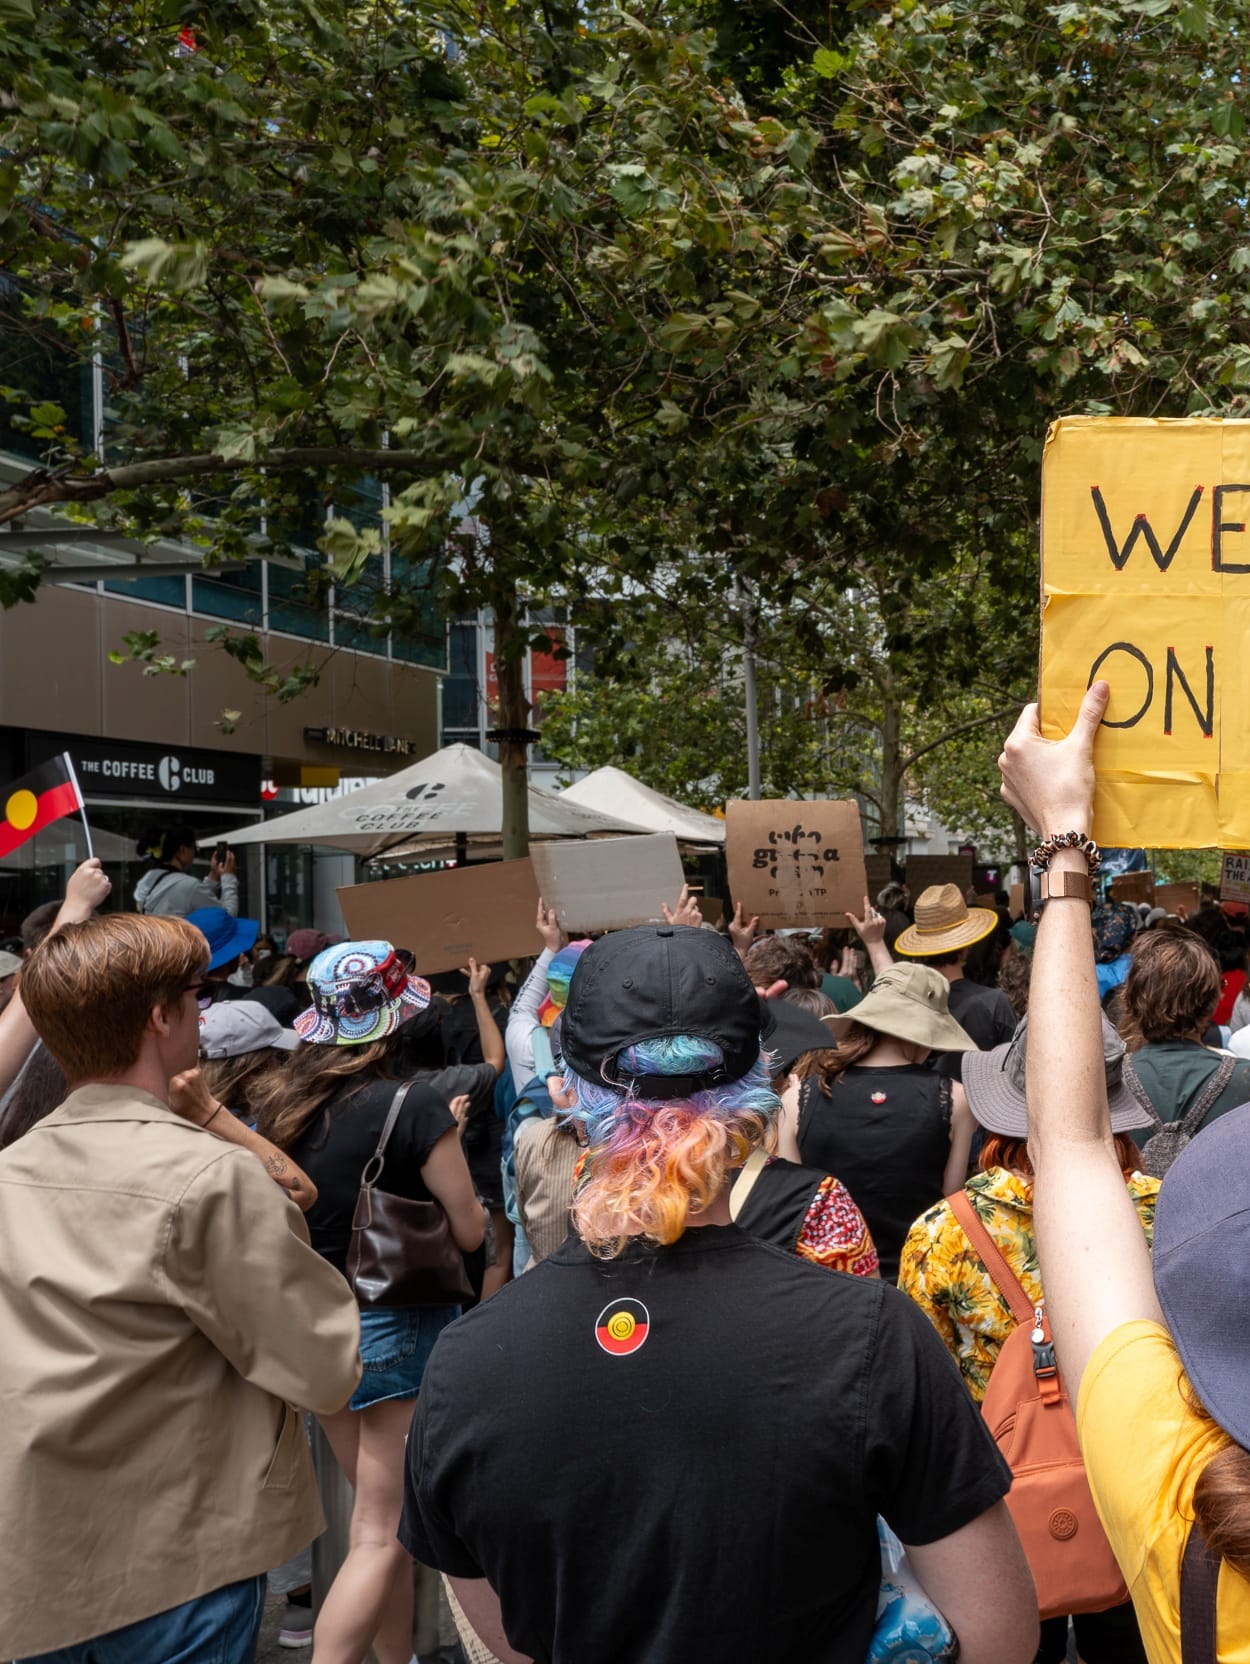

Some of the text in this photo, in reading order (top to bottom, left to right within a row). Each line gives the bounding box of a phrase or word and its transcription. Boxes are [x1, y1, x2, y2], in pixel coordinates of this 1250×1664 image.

[1087, 641, 1214, 739] ON
[81, 760, 100, 773] THE
[102, 759, 155, 780] COFFEE
[183, 767, 215, 785] CLUB
[355, 811, 443, 823] COFFEE
[360, 821, 421, 831] CLUB
[823, 848, 840, 861] a
[1224, 869, 1246, 881] THE
